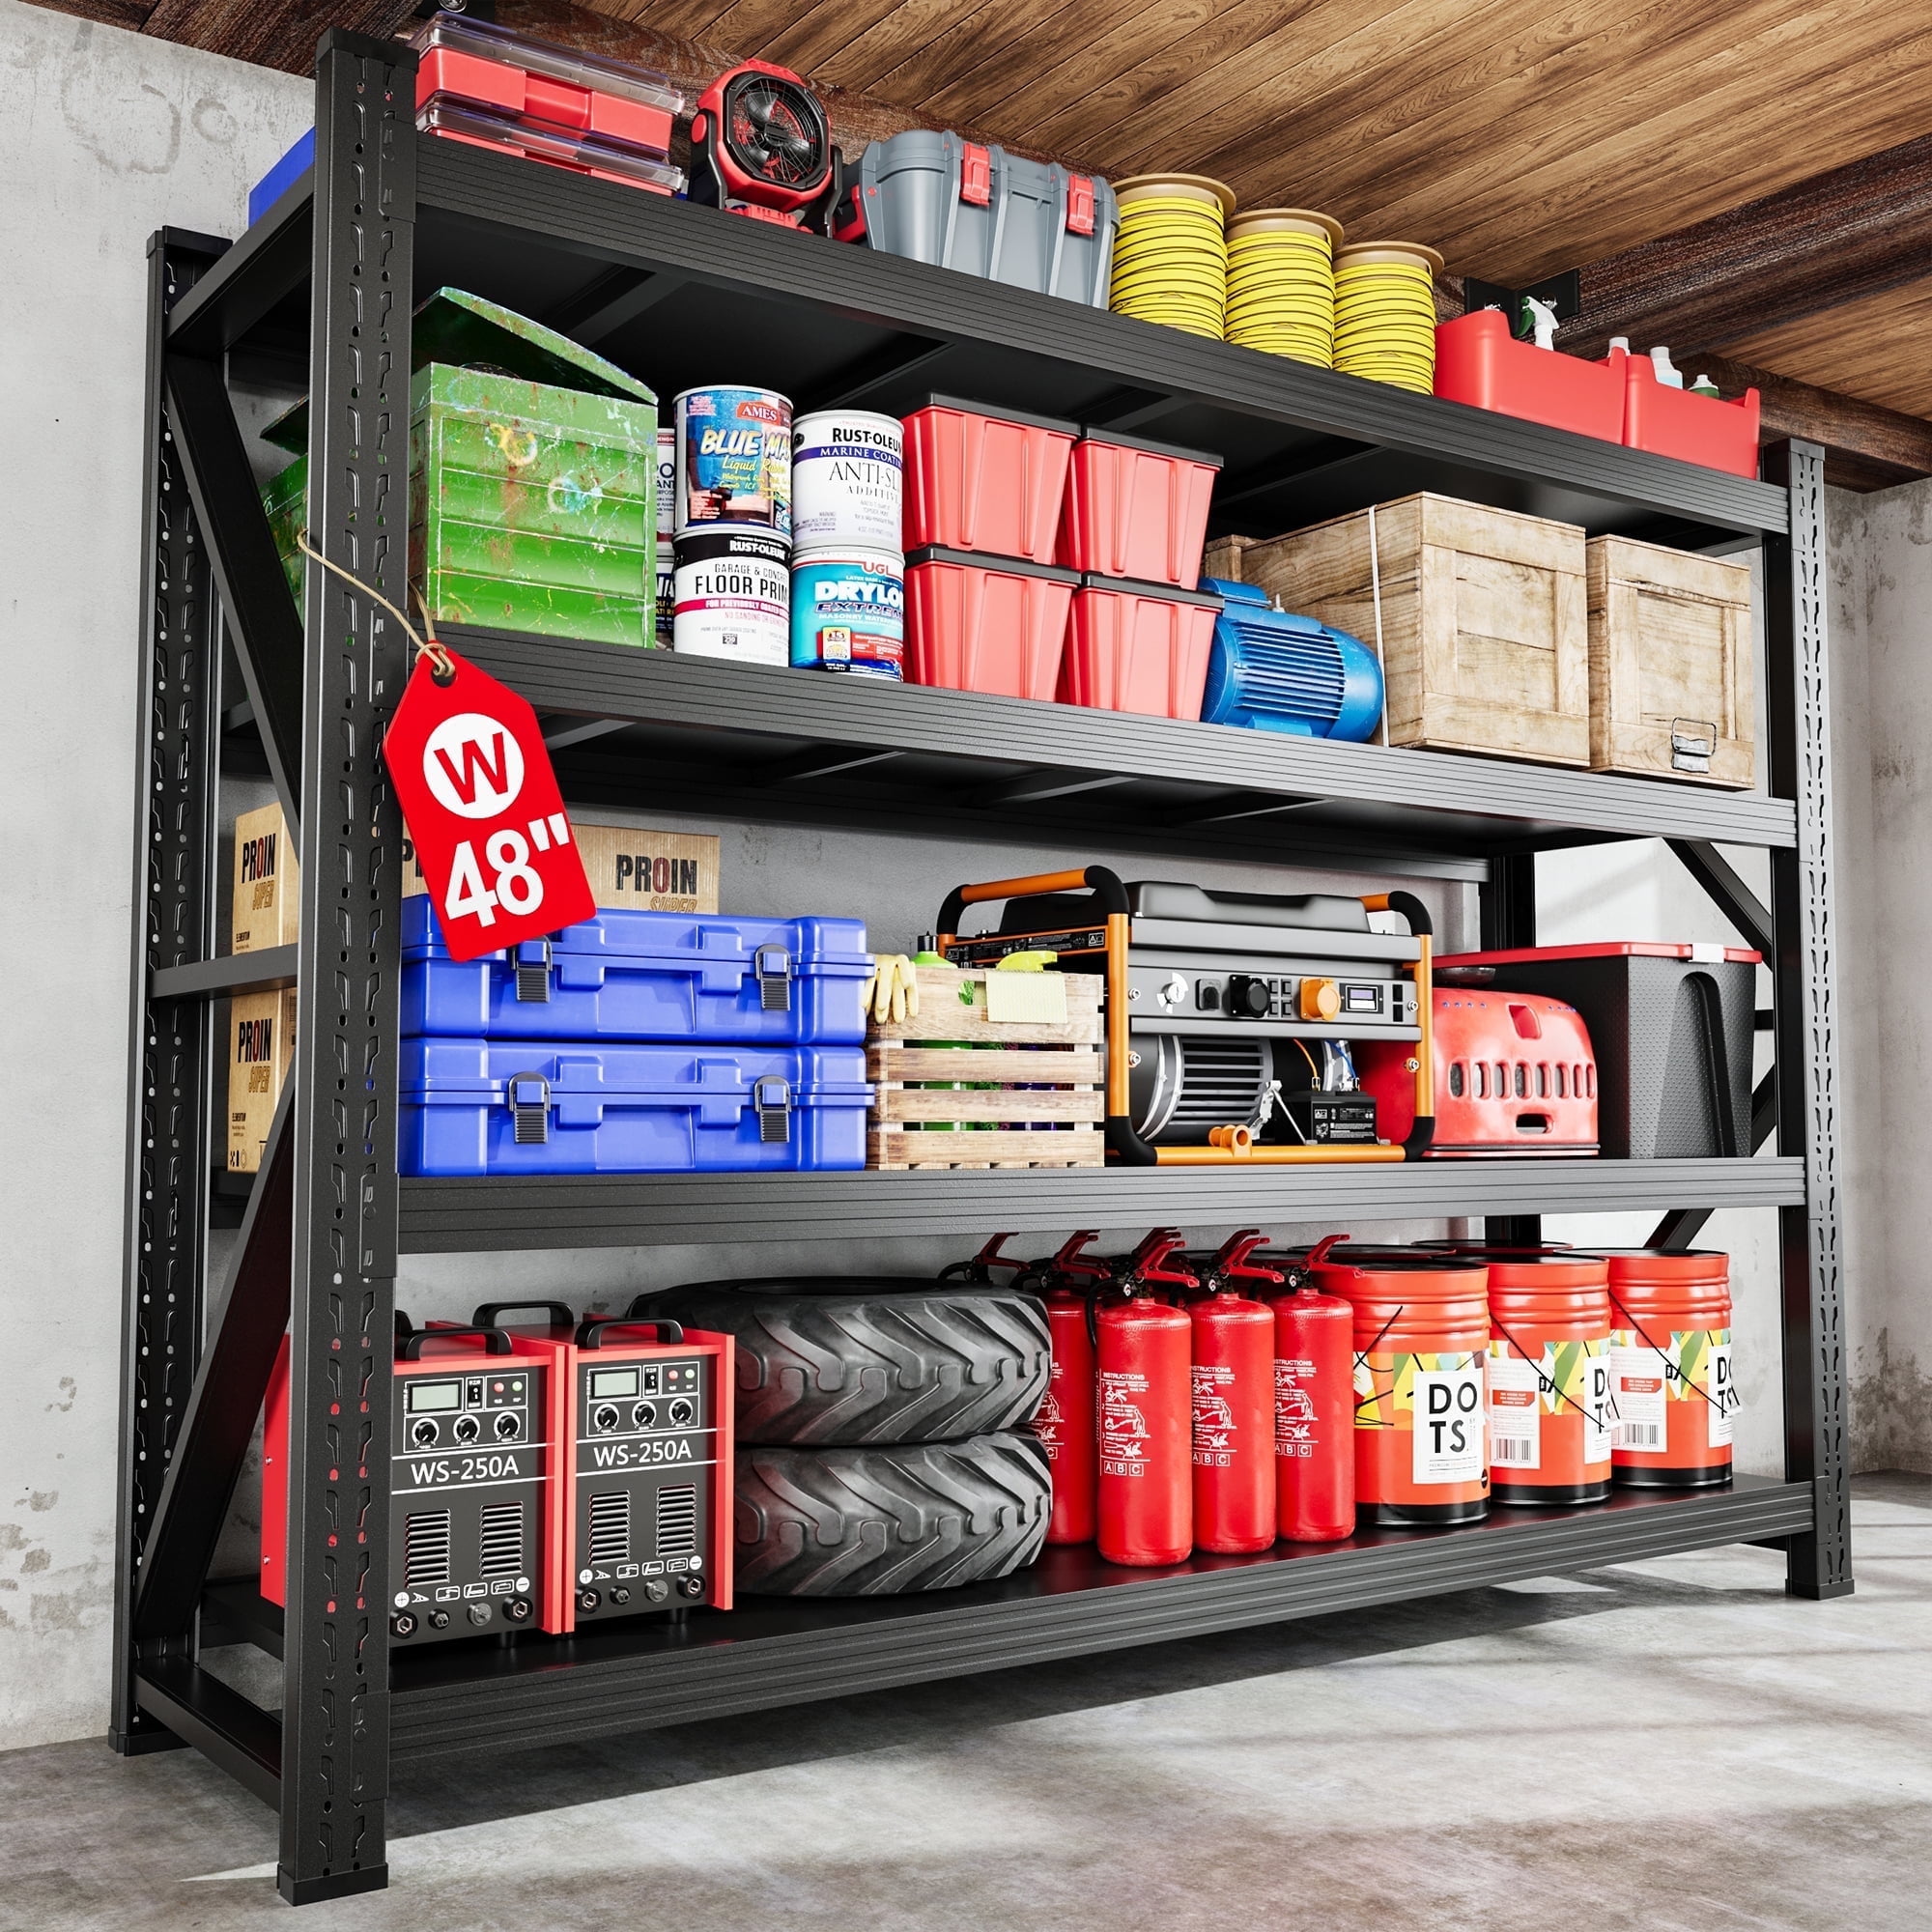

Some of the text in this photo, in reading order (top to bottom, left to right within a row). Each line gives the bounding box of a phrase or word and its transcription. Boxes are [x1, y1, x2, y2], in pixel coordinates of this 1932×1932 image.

[742, 406, 778, 422] AMES
[699, 428, 763, 458] BLUE
[820, 447, 869, 458] MARINE
[722, 454, 757, 474] Liquid
[715, 563, 752, 575] GARAGE
[864, 561, 891, 578] UGL
[695, 575, 753, 596] FLOOR
[433, 731, 509, 805] W
[242, 833, 276, 884] PROIN
[444, 812, 570, 927] 48"
[615, 854, 697, 895] PROIN
[238, 1018, 272, 1063] PROIN
[1429, 1381, 1478, 1414] DO
[1429, 1419, 1466, 1453] TS
[594, 1439, 693, 1467] WS-250A
[411, 1454, 520, 1485] WS-250A
